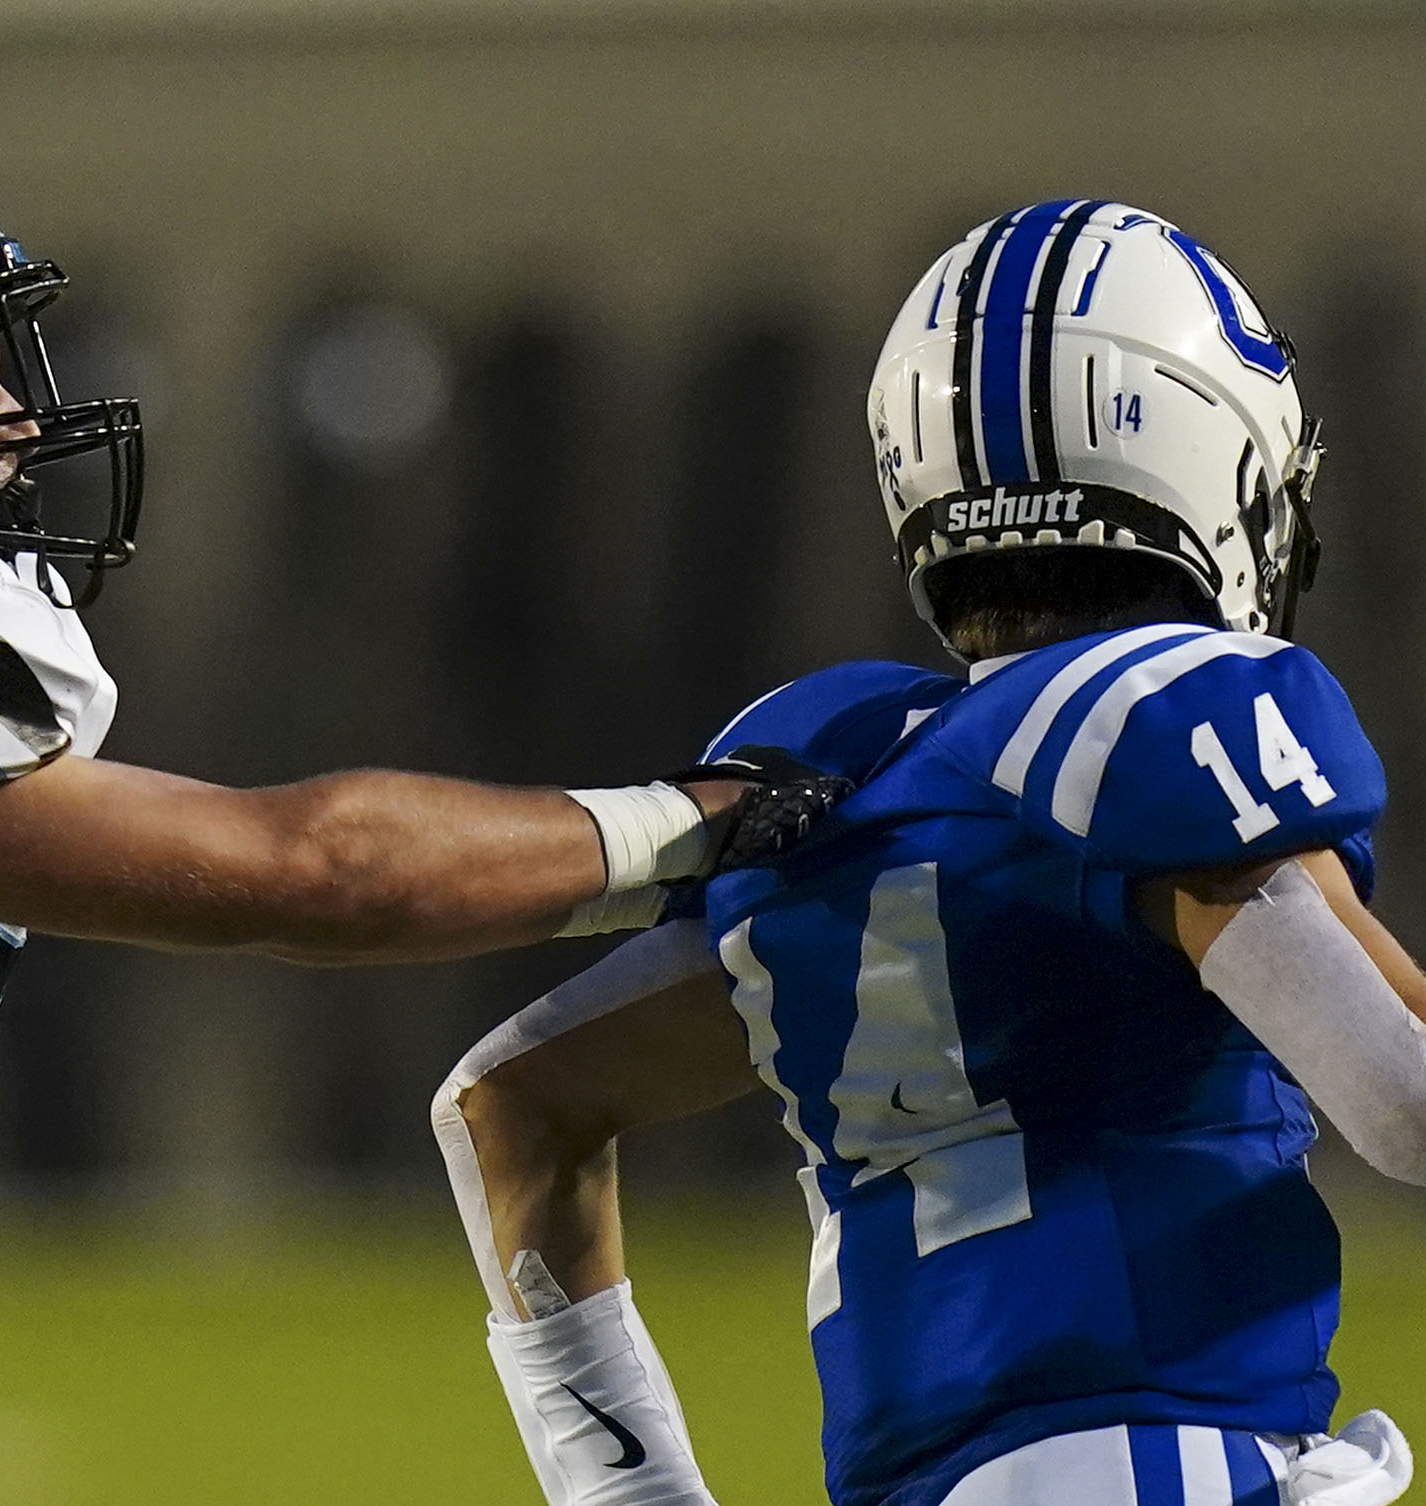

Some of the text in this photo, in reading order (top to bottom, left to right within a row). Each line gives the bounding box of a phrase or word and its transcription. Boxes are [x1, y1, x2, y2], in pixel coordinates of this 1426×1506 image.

[1113, 393, 1142, 432] 14
[947, 487, 1085, 533] schutt
[1191, 692, 1337, 844] 14
[718, 861, 1033, 1334] 14
